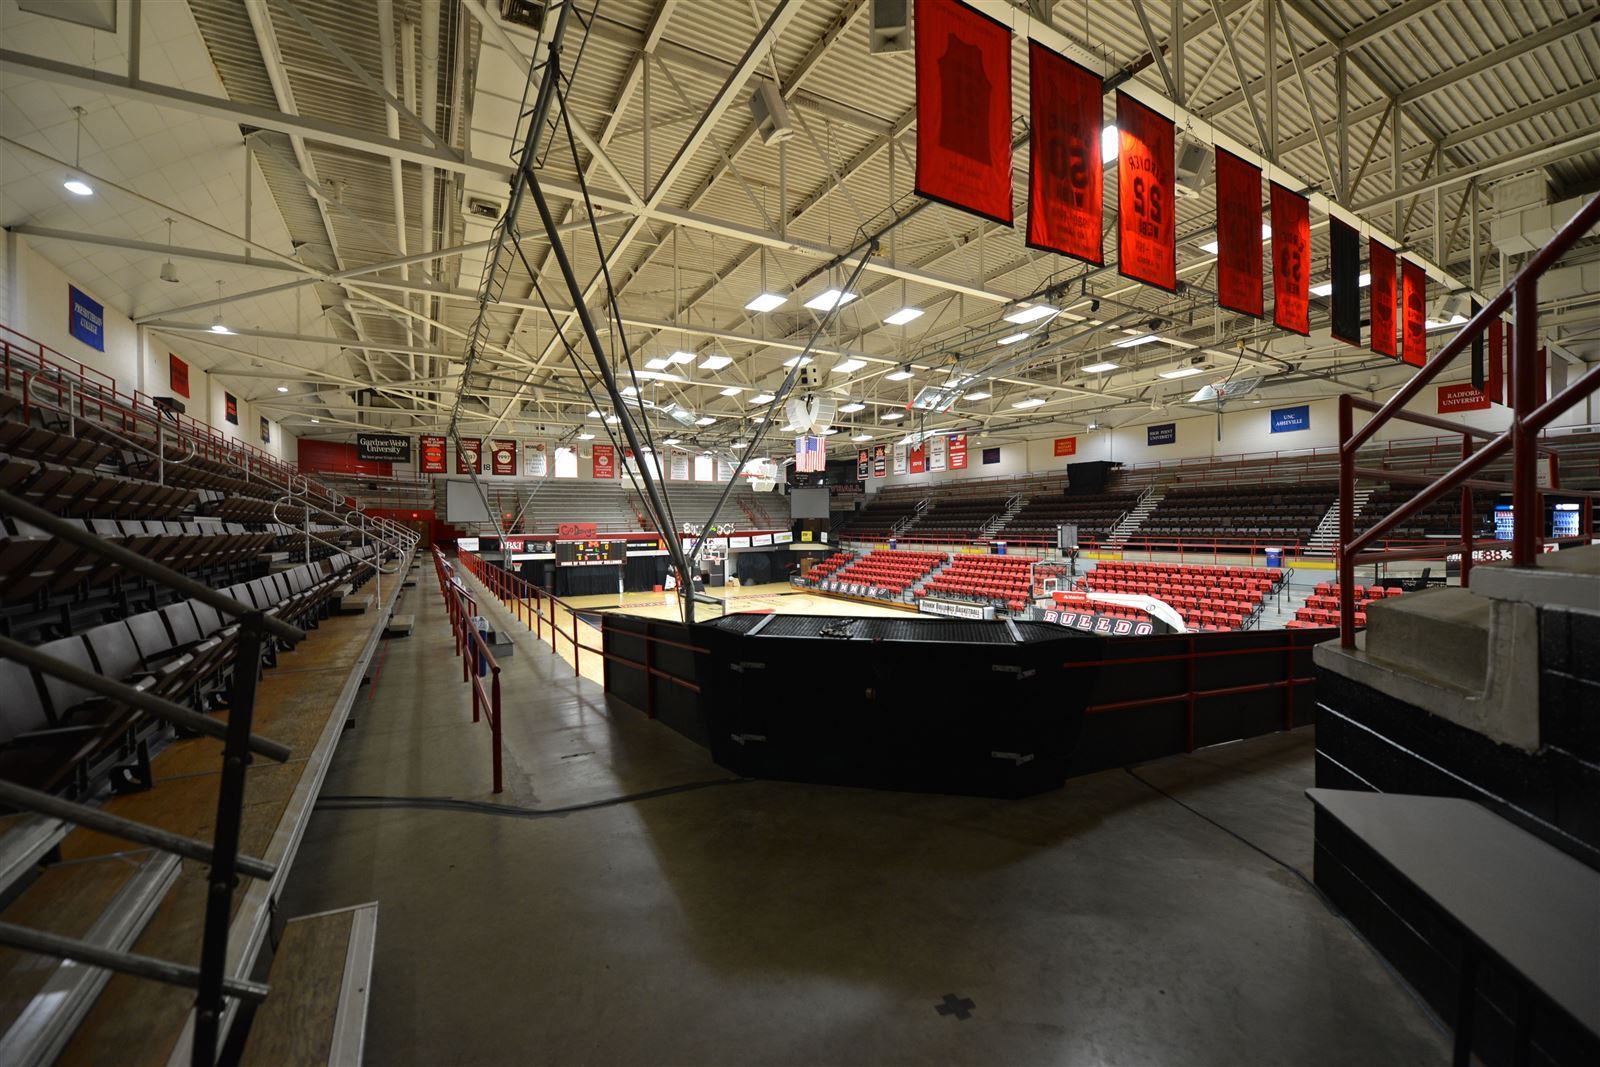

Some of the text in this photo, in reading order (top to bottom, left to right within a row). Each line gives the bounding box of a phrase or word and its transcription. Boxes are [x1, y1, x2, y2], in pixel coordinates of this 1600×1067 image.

[1442, 395, 1486, 406] UNIVERSITY
[366, 445, 401, 454] University
[483, 463, 491, 471] 18
[1044, 610, 1199, 636] BULLDO
